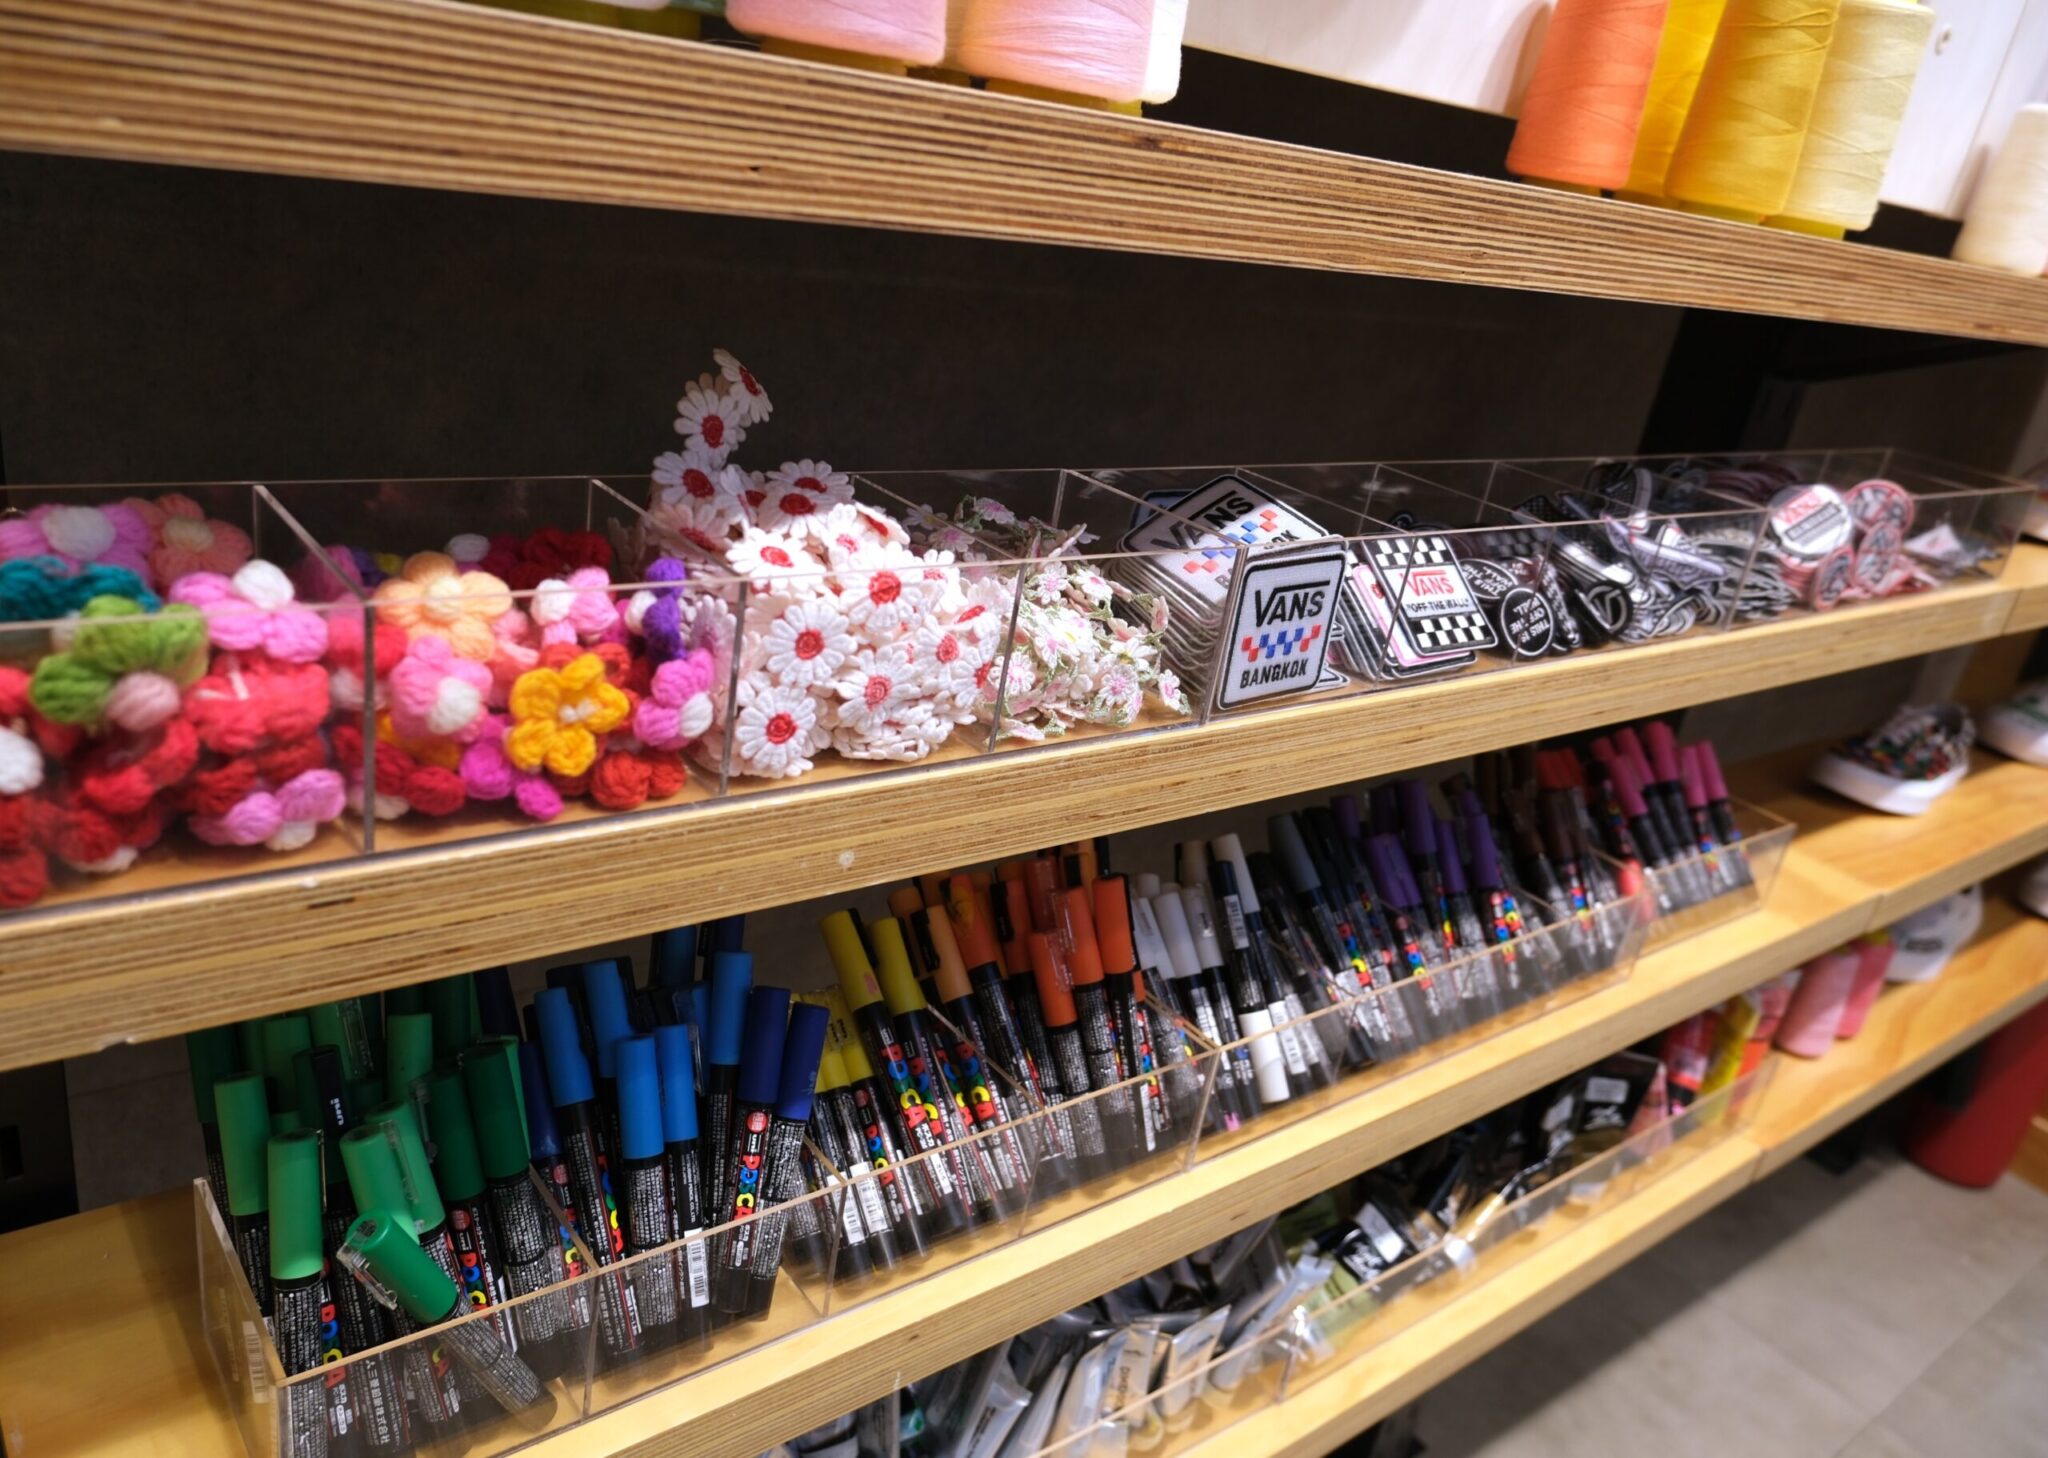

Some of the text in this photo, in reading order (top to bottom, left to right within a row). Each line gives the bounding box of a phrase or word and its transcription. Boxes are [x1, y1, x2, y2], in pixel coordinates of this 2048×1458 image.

[1398, 570, 1454, 597] VANS
[1254, 580, 1331, 627] VANS
[1428, 600, 1446, 611] THE
[1529, 620, 1550, 637] THIS
[1240, 659, 1308, 689] BANGKOK
[881, 1043, 927, 1129] POSCA
[955, 1041, 995, 1122] POSCA
[331, 1098, 344, 1125] uni
[749, 1133, 757, 1152] uni
[921, 1122, 935, 1147] ポスカ
[734, 1154, 762, 1221] POSCA
